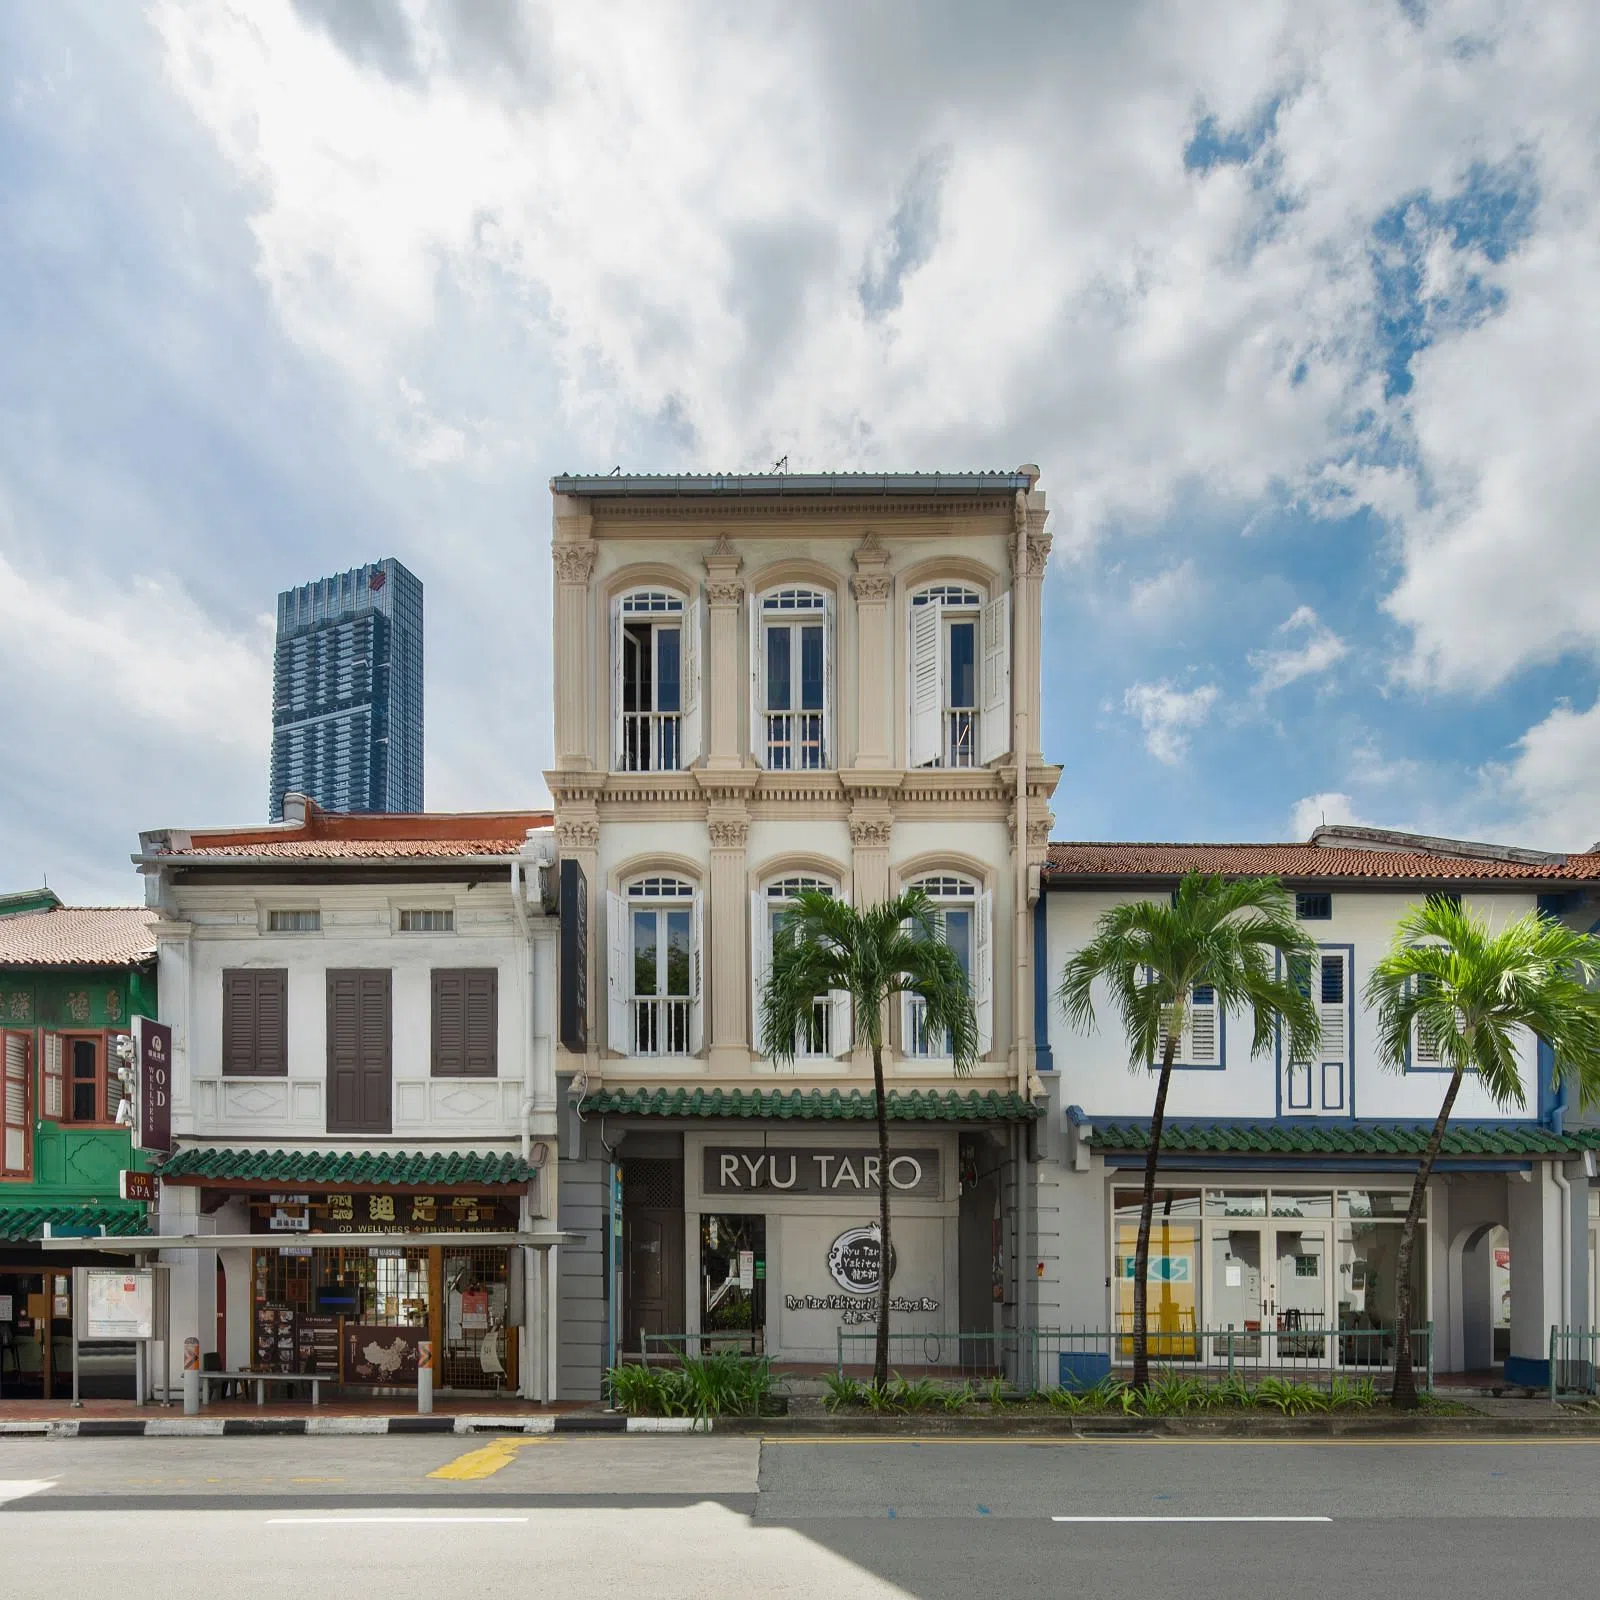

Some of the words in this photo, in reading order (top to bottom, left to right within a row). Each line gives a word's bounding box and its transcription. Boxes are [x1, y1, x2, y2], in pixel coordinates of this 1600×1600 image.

[720, 1154, 797, 1188] RYU
[812, 1155, 922, 1190] TARO
[134, 1176, 147, 1185] OD
[130, 1185, 150, 1197] SPA
[338, 1225, 353, 1233] OD
[358, 1225, 410, 1233] WELLNESS
[843, 1245, 860, 1257] Ryu
[786, 1295, 805, 1311] Ryu
[806, 1295, 828, 1309] Taro
[828, 1295, 871, 1310] Yakitori
[888, 1297, 921, 1313] zakaya
[921, 1297, 938, 1311] Bar
